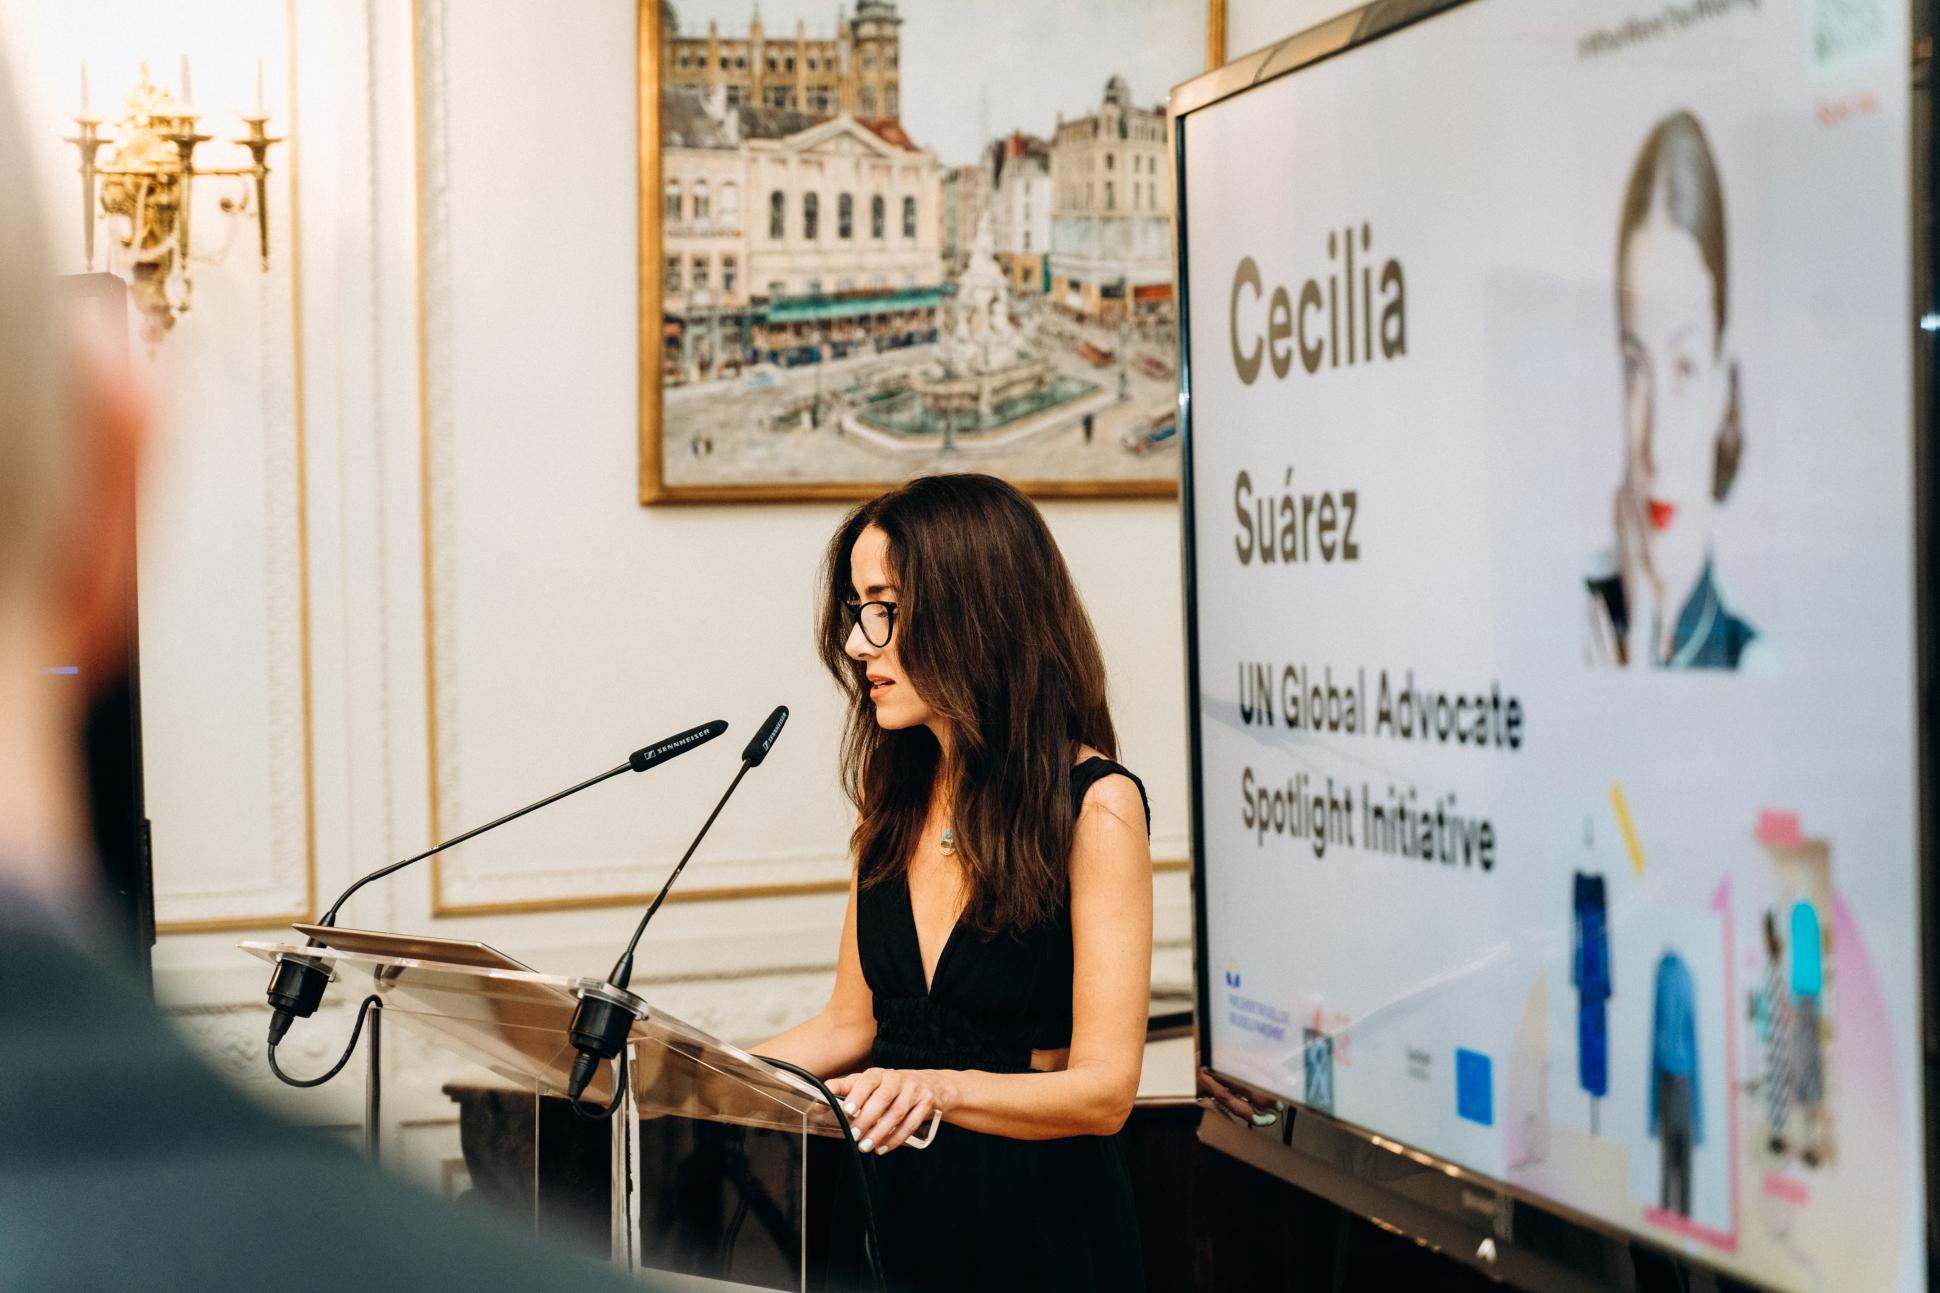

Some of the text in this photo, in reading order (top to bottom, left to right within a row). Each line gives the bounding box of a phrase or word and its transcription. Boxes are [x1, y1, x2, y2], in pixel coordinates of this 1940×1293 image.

[1230, 221, 1407, 386] Cecilia
[1235, 466, 1359, 566] Suárez
[657, 728, 710, 754] SENNHEISER
[1239, 661, 1523, 749] UN Global Advocate
[1242, 765, 1496, 873] Spotlight Initiative
